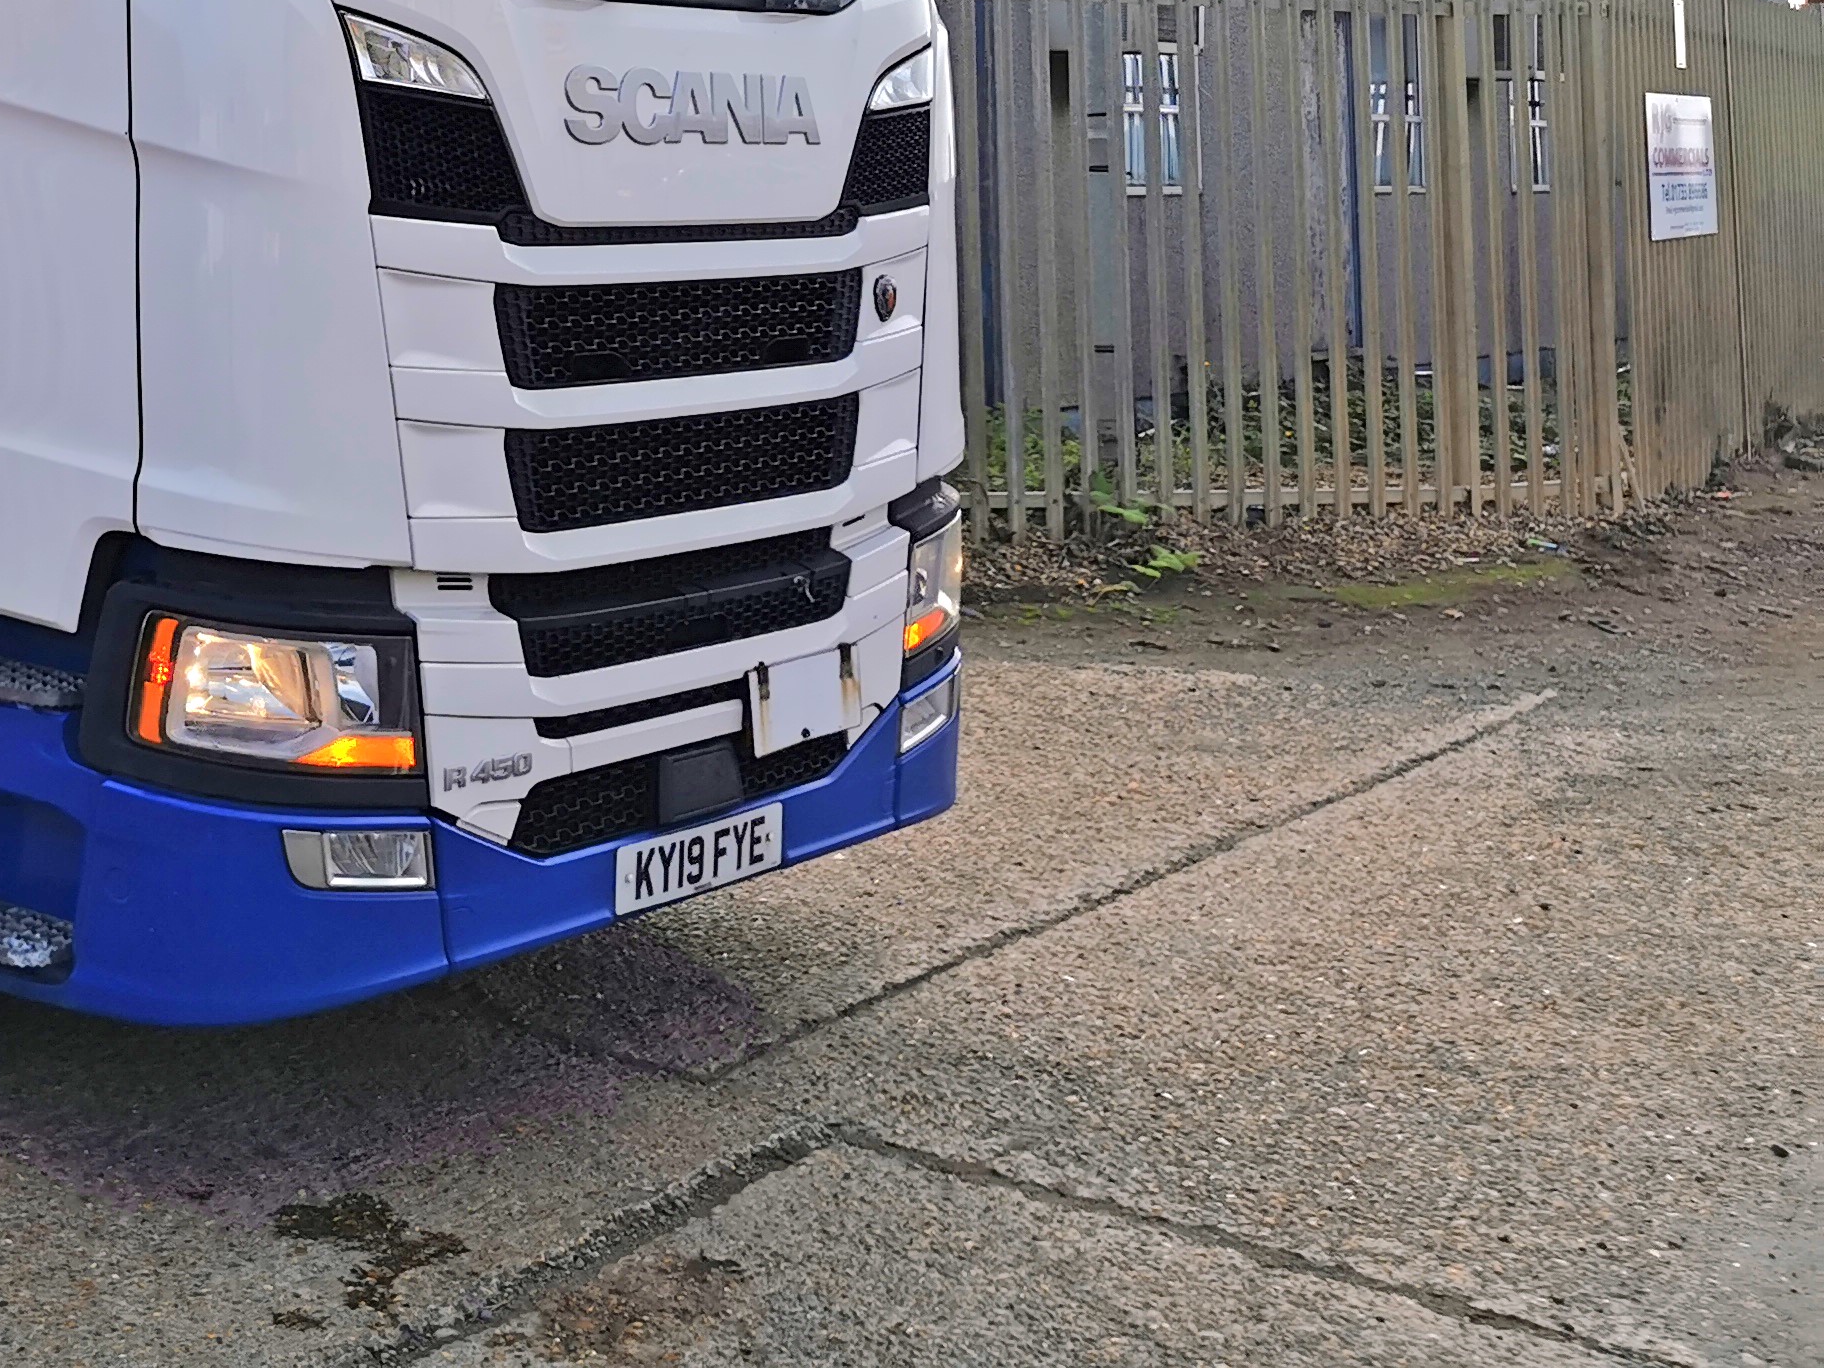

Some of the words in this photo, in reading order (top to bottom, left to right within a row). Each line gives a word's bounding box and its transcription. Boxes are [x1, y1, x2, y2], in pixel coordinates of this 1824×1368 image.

[563, 63, 822, 146] SCANIA
[1652, 146, 1710, 169] COMMERCIALS
[442, 764, 467, 792] R
[469, 751, 534, 786] 450
[633, 835, 705, 901] KY19
[712, 816, 766, 878] FYE
